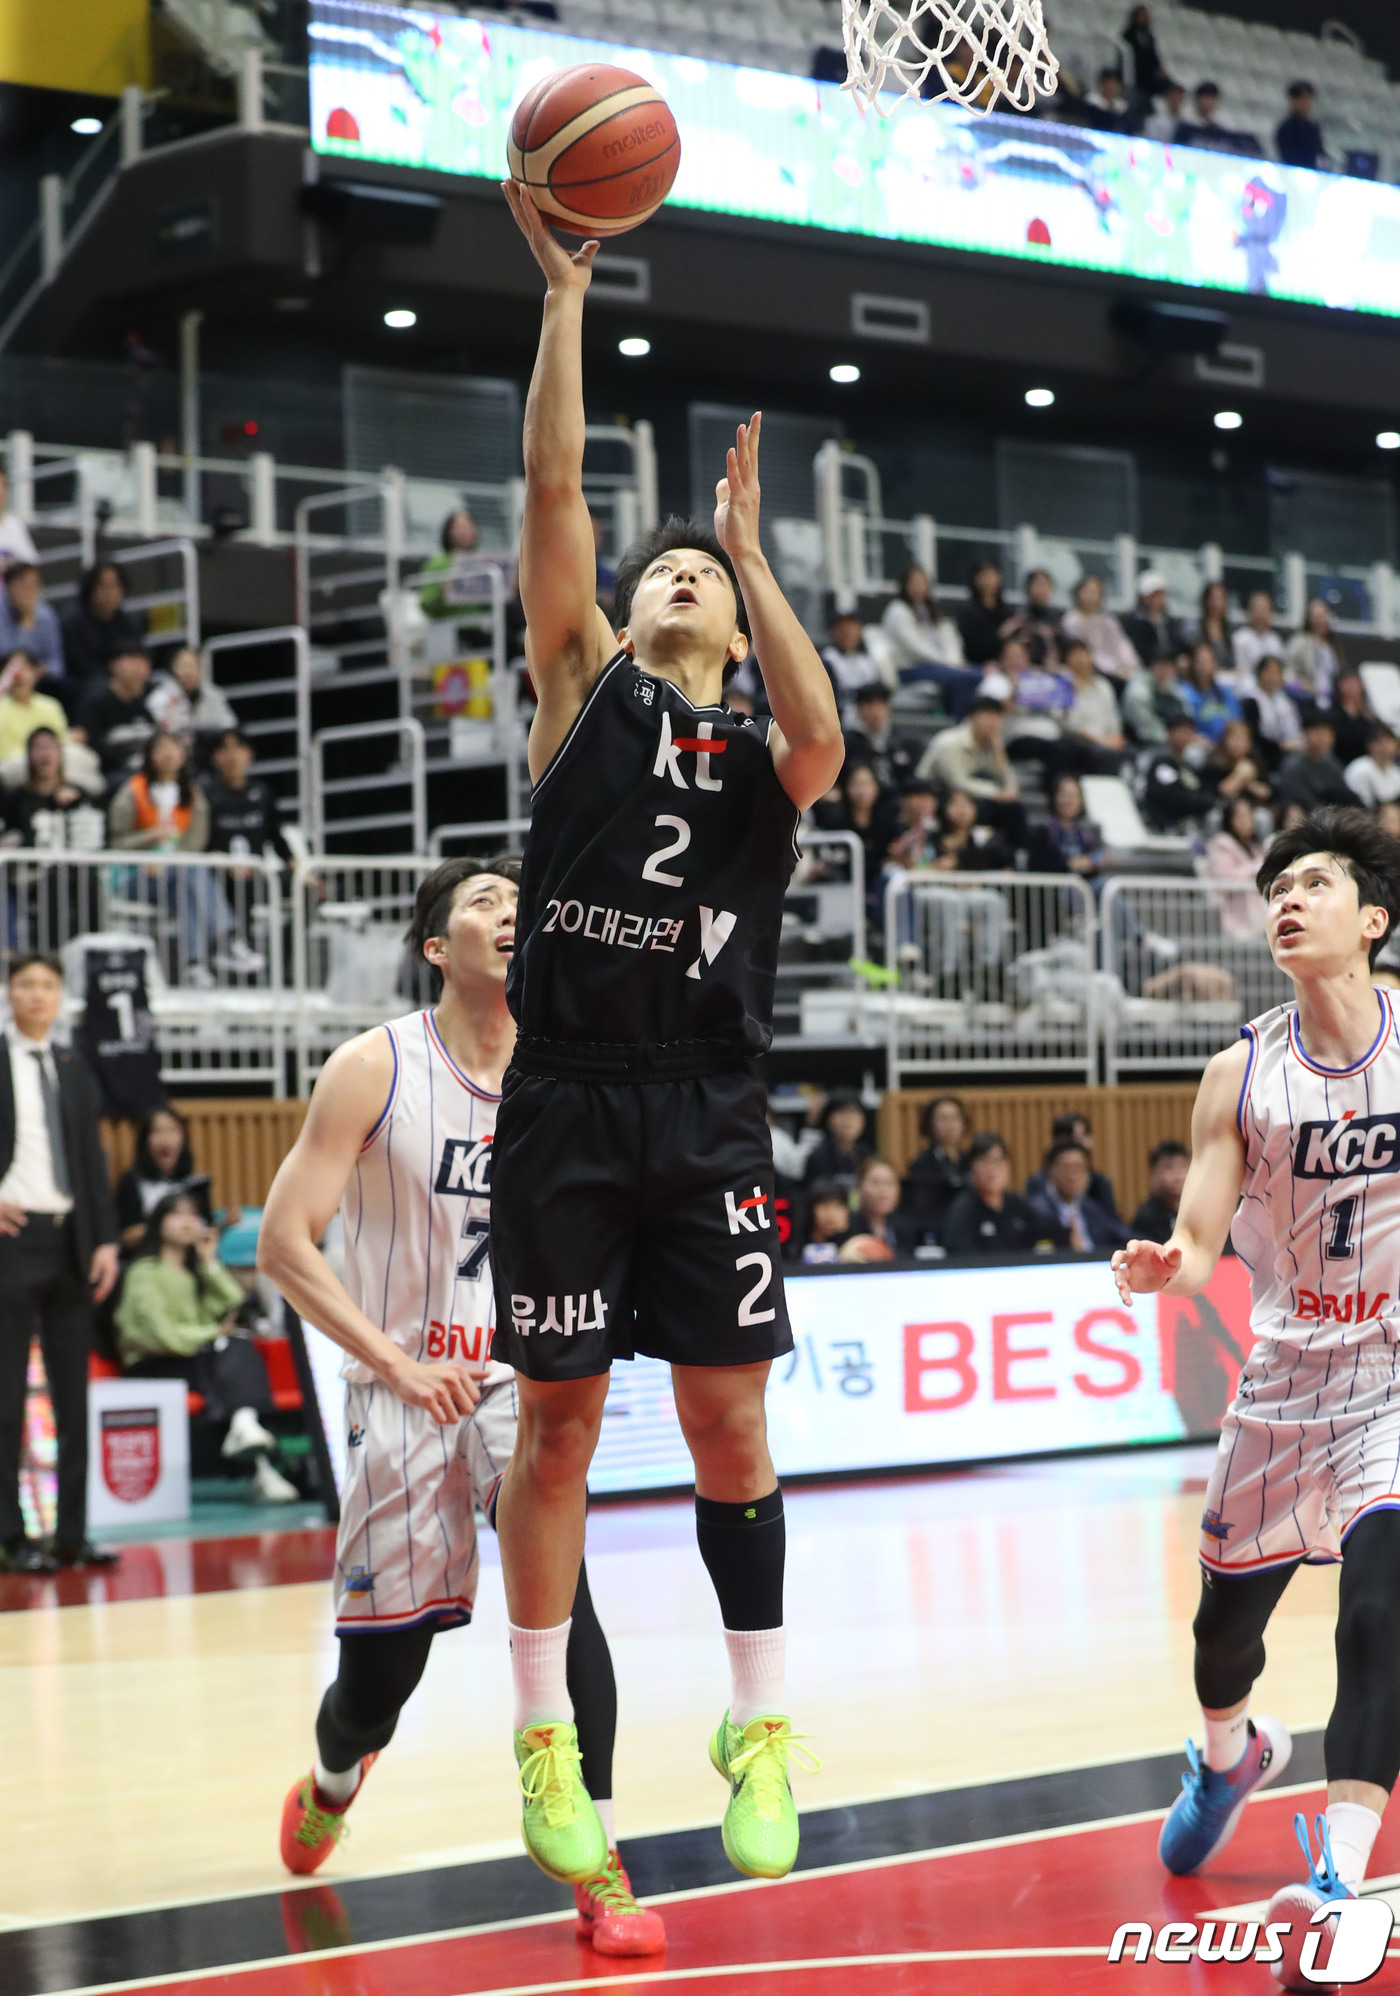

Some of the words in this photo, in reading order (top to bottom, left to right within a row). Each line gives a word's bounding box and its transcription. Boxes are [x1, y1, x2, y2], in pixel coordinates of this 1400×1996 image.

[602, 120, 666, 159] molten
[652, 711, 728, 792] kt
[642, 814, 692, 888] 2
[106, 992, 136, 1041] 1
[1303, 1110, 1397, 1174] KCC
[724, 1186, 771, 1235] kt
[1325, 1195, 1359, 1261] 1
[455, 1217, 490, 1282] 7
[510, 1288, 608, 1337] 유사나
[735, 1251, 776, 1327] 2
[427, 1320, 495, 1362] BN
[766, 1336, 875, 1398] 기공
